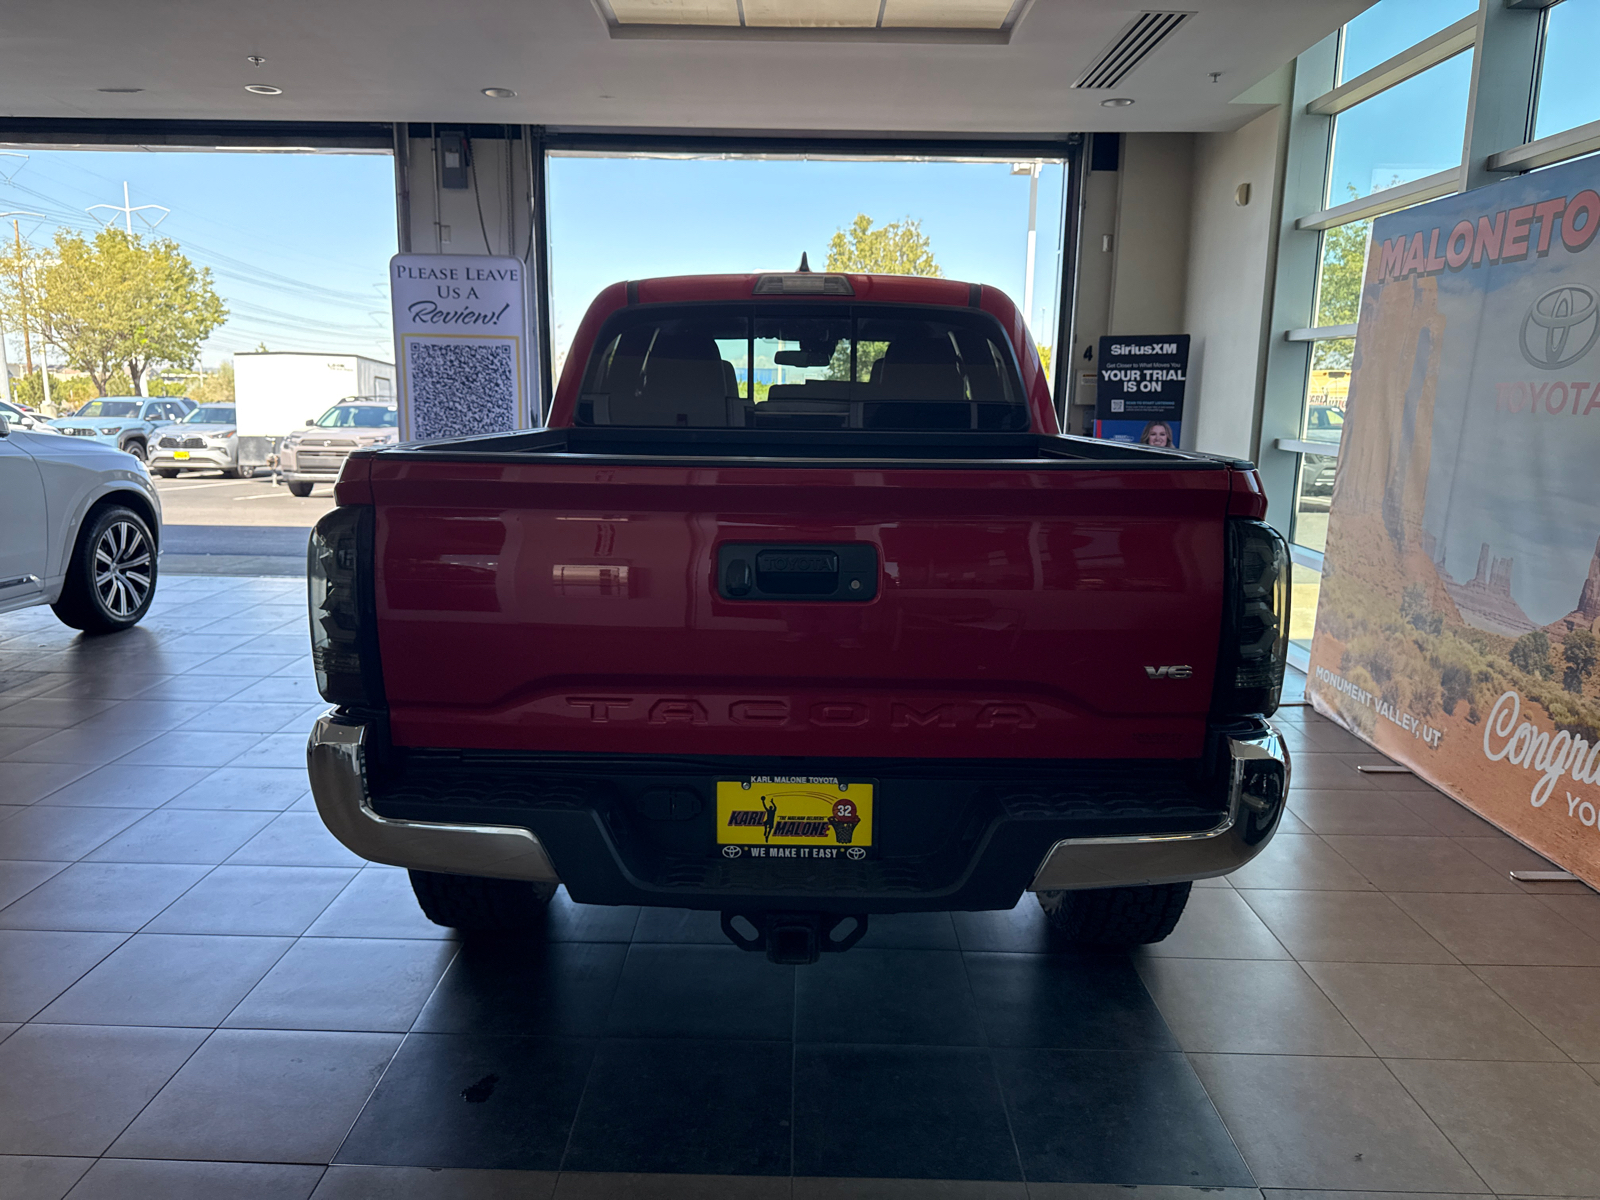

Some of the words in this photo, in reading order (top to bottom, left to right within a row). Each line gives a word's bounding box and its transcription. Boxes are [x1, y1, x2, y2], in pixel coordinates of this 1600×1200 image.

[466, 287, 480, 300] A
[407, 300, 510, 325] Review!
[1083, 345, 1093, 361] 4
[1110, 343, 1177, 356] SiriusXM
[1101, 370, 1140, 381] YOUR
[1143, 370, 1186, 380] TRIAL
[1123, 381, 1137, 392] IS
[1140, 381, 1162, 392] ON
[764, 556, 832, 571] TOYOTA
[1143, 664, 1193, 679] V6
[565, 696, 1037, 729] TACOMA
[1315, 665, 1372, 707] MONUMENT
[1374, 697, 1420, 739] VALLEY,
[1422, 724, 1441, 747] UT
[774, 776, 807, 784] MALONE
[727, 810, 767, 826] KARL
[837, 805, 852, 817] 32
[1566, 791, 1600, 832] YO
[772, 821, 830, 837] MALONE
[751, 848, 766, 857] WE
[769, 848, 797, 857] MAKE
[800, 848, 810, 857] IT
[813, 848, 837, 858] EASY
